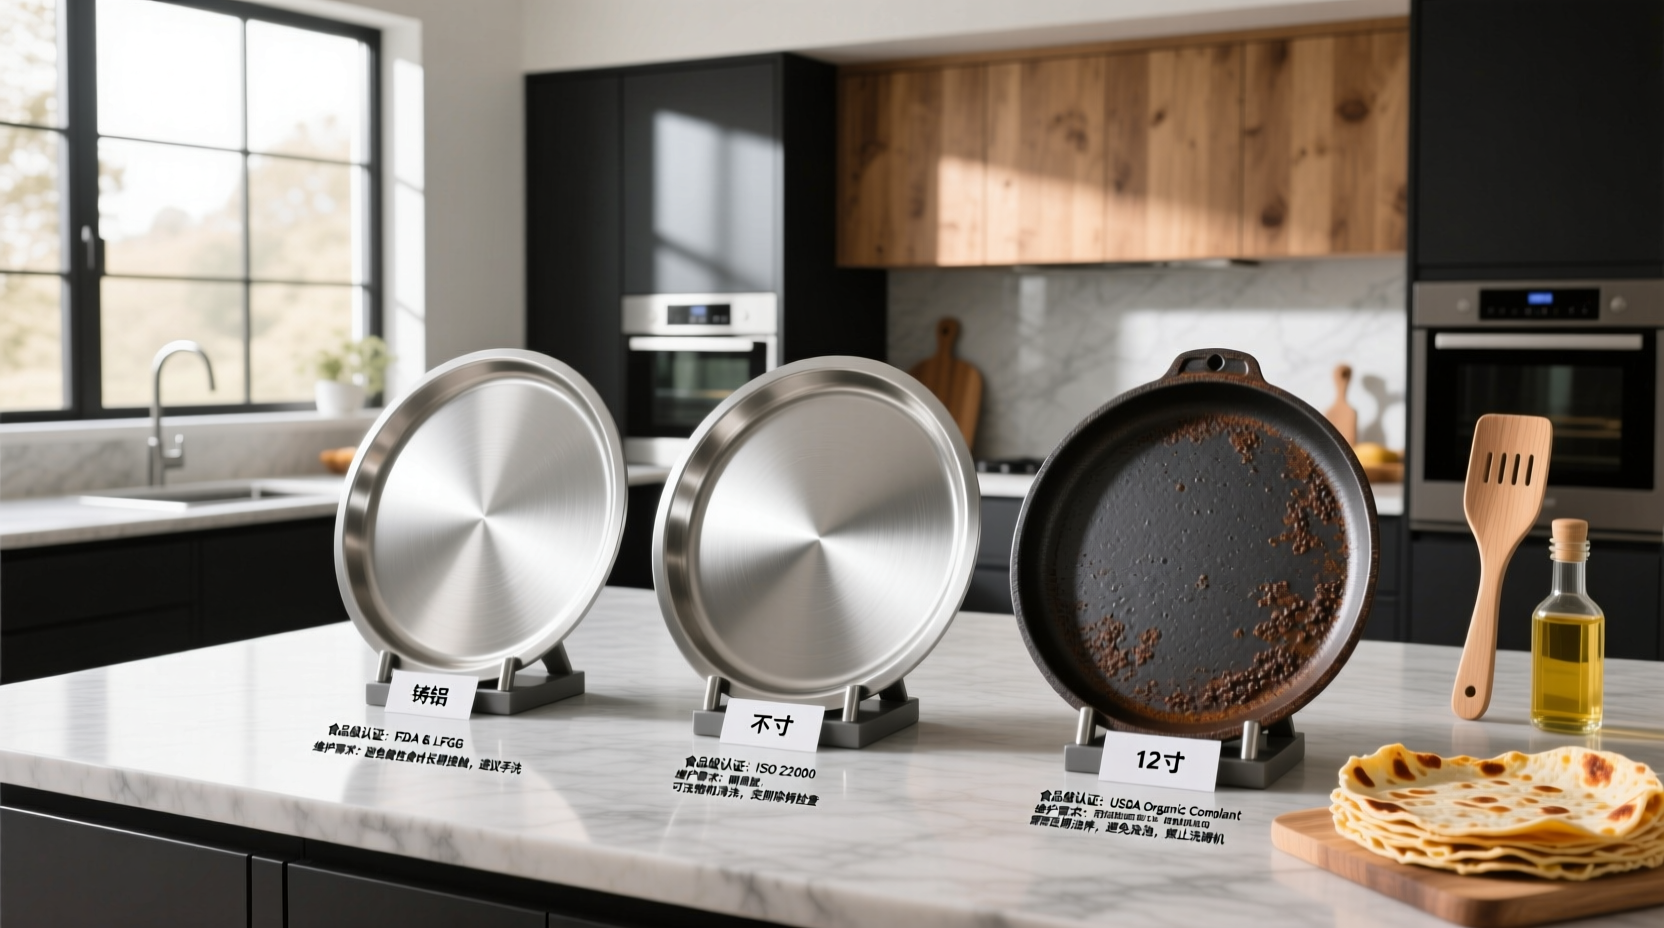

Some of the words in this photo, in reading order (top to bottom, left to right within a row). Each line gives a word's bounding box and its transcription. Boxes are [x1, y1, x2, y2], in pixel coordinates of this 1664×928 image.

[750, 713, 794, 737] 不寸
[394, 731, 419, 744] FDA
[755, 762, 777, 775] ISO
[778, 765, 817, 779] 22000
[1136, 751, 1186, 774] 12寸
